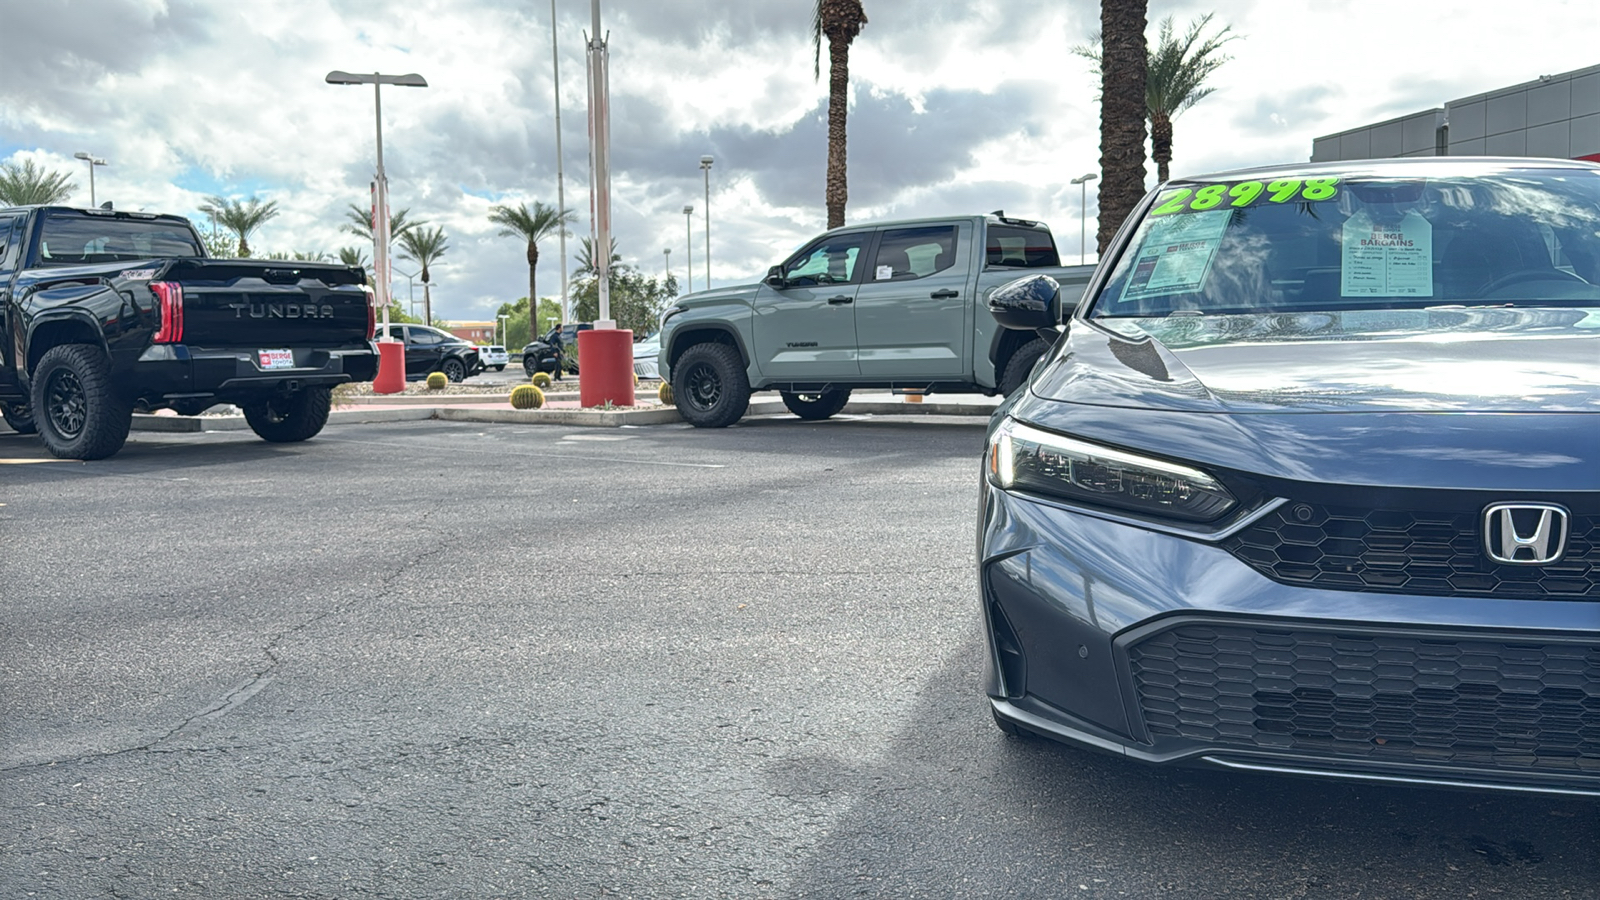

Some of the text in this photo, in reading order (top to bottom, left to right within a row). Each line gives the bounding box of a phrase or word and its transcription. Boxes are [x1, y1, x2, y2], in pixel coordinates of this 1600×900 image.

[1151, 177, 1341, 215] 28998
[1360, 239, 1414, 247] BARGAINS
[229, 304, 334, 318] TUNDRA
